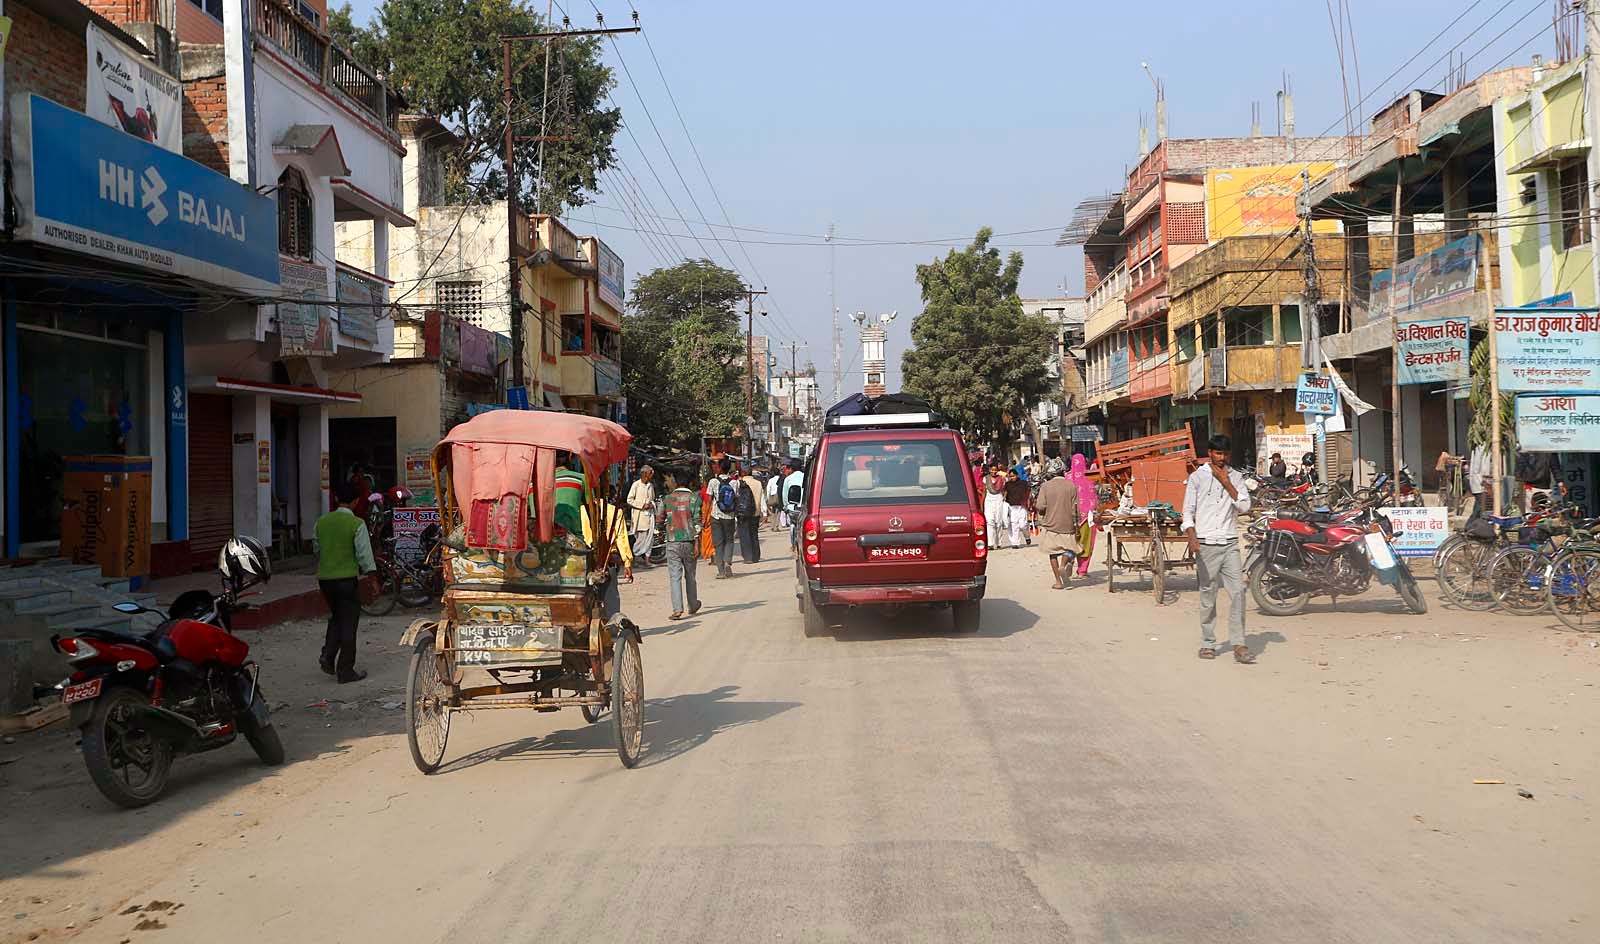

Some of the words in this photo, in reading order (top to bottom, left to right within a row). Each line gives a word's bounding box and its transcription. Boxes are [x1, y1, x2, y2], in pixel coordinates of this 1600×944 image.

[178, 190, 245, 242] BAJAJ
[44, 225, 87, 245] AUTHORISED
[117, 244, 133, 257] KHAN
[135, 249, 149, 261] AUTO
[150, 251, 173, 266] MOBILES
[1445, 320, 1467, 339] सिंह
[1538, 316, 1574, 337] कुमार
[1534, 397, 1577, 411] आशा
[1407, 519, 1426, 531] रेखा
